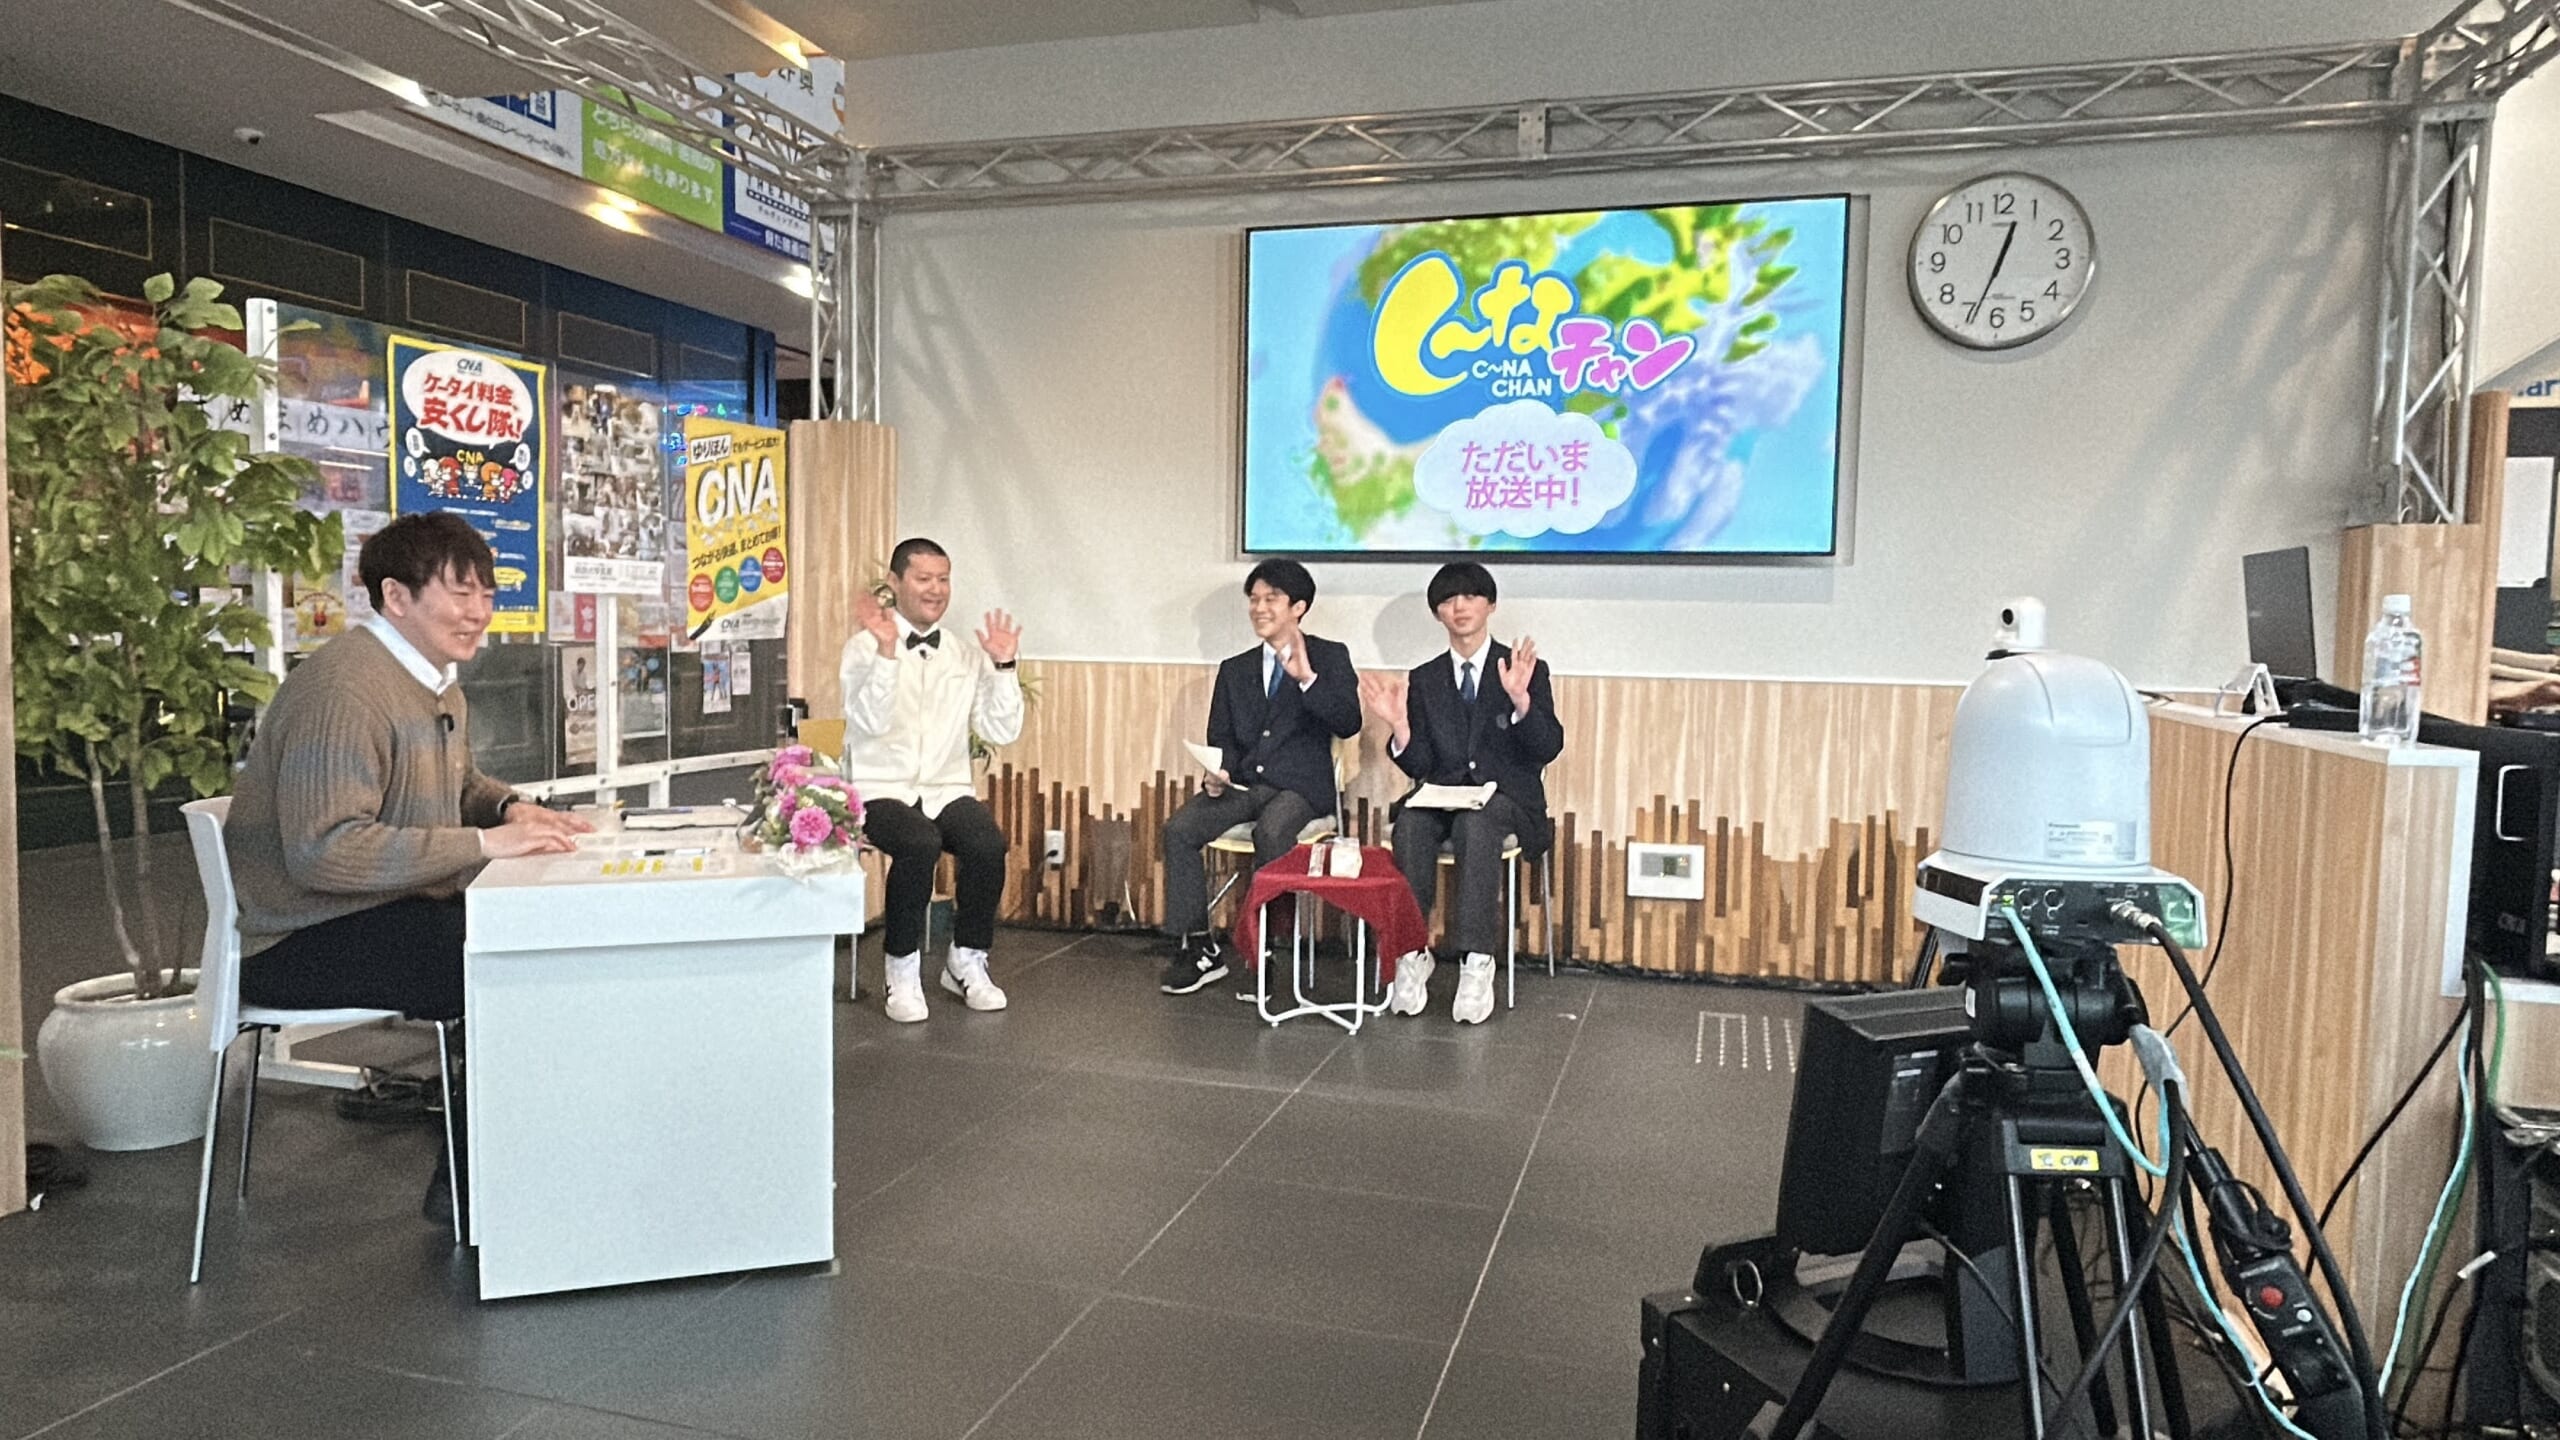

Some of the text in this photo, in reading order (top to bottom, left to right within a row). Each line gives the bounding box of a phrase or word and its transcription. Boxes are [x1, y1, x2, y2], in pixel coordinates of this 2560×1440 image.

[1966, 202, 1984, 223] 11
[1992, 193, 2015, 214] 12
[2032, 199, 2038, 220] 1
[1942, 223, 1963, 244] 10
[2049, 218, 2064, 241] 2
[1930, 252, 1946, 273] 9
[2055, 248, 2070, 269] 3
[1939, 283, 1955, 304] 8
[2044, 280, 2060, 301] 4
[1962, 302, 1977, 324] 7
[1989, 307, 2005, 328] 6
[2020, 300, 2035, 322] 5
[457, 358, 483, 373] CNA
[424, 373, 519, 411] ケータイ料金、
[1491, 378, 1552, 397] CHAN
[420, 397, 523, 440] 安くし隊!
[456, 449, 485, 464] CNA
[1461, 439, 1590, 475] ただいま
[696, 456, 778, 527] CNA
[1465, 475, 1579, 510] 放送中!
[568, 693, 595, 712] OPE
